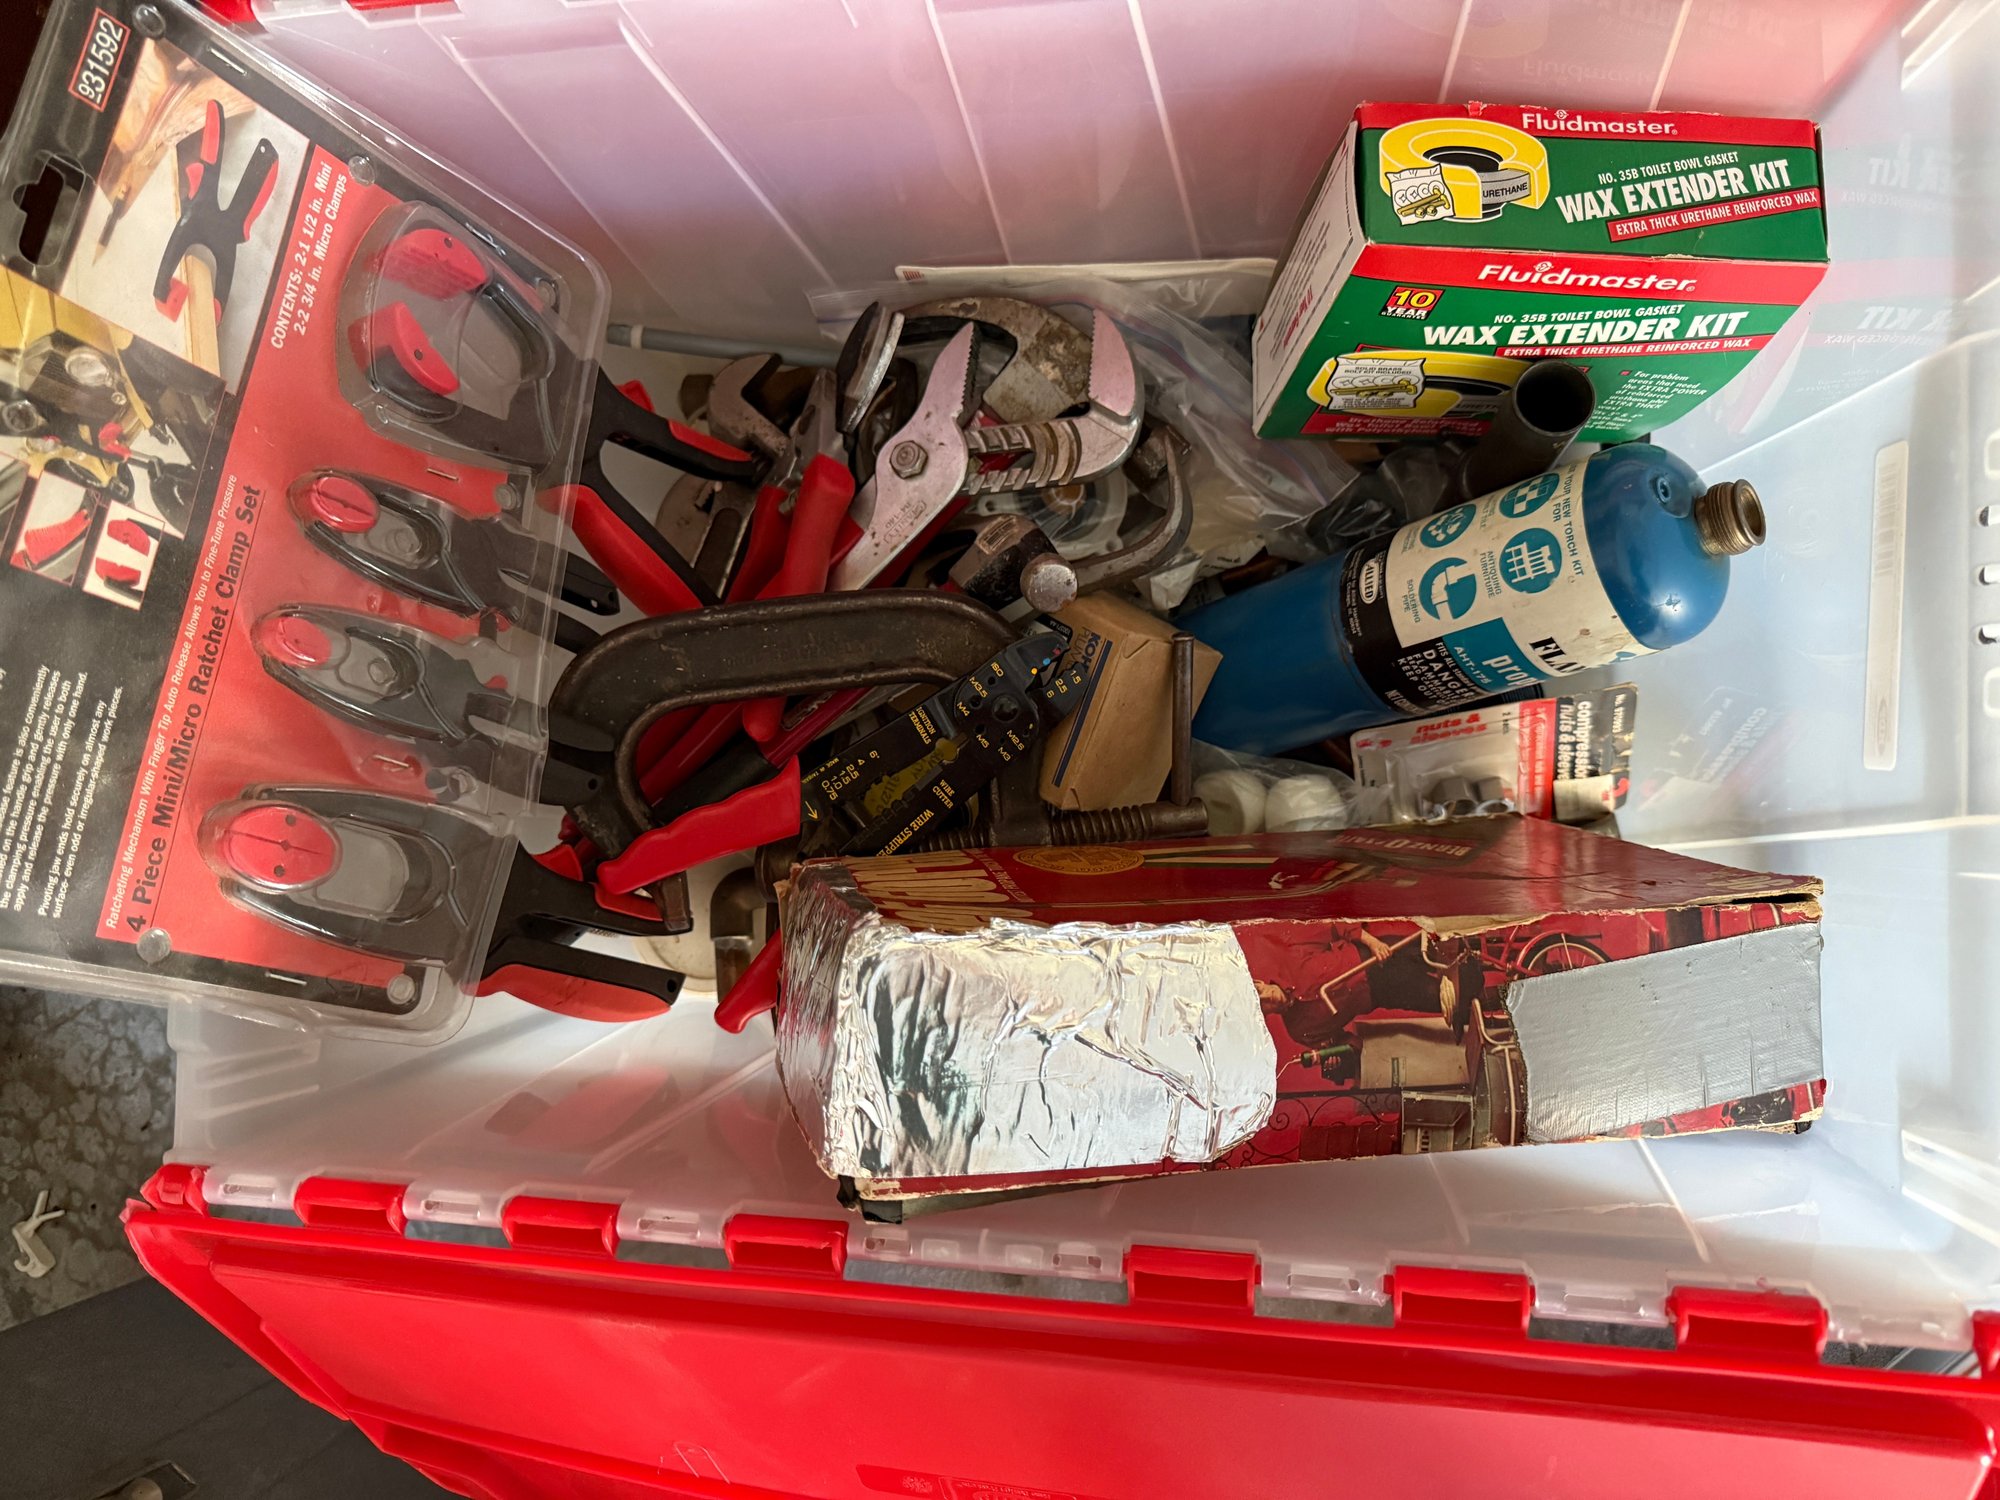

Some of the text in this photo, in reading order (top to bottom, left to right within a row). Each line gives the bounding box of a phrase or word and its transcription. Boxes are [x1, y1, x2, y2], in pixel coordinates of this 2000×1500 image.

[73, 17, 127, 103] 931592
[1521, 109, 1677, 135] Fluidmaster
[1598, 151, 1738, 184] NO. 35B TOILET BOWL GASKET
[1483, 182, 1528, 198] URETHANE
[1555, 159, 1792, 224] WAX EXTENDER KIT
[1616, 191, 1818, 237] EXTRA THICK URETHANE REINFORCED WAX
[269, 160, 334, 349] CONTENTS: 2-1 1/2 in. Mini
[292, 172, 350, 335] 2-2 3/4 in. Micro Clamps
[1477, 261, 1697, 292] Fluidmaster
[1387, 306, 1428, 316] YEAR
[1396, 290, 1436, 308] 10
[1494, 304, 1685, 324] NO. 35B TOILET BOWL GASKET
[1423, 311, 1750, 346] WAX EXTENDER KIT
[1503, 338, 1752, 357] EXTRA THICK URETHANE REINFORCED WAX
[1650, 373, 1689, 381] problem
[1610, 395, 1649, 403] urethane
[1626, 391, 1675, 399] reinforced
[1559, 475, 1575, 495] YOUR
[1550, 503, 1563, 521] FOR
[1558, 497, 1574, 519] NEW
[1560, 521, 1581, 556] TORCH
[1476, 552, 1496, 598] FURNITURE
[1484, 550, 1503, 595] ANTIQUING
[1571, 559, 1584, 576] KIT
[1360, 563, 1377, 599] ALLIED
[1401, 594, 1412, 612] PIPE
[1405, 579, 1422, 623] SOLDERING
[1434, 641, 1457, 673] FITS ALL
[1453, 647, 1489, 685] AHT-175
[1054, 677, 1068, 693] 2.5
[1068, 669, 1081, 684] 1.5
[1397, 656, 1435, 703] KEEP OUT
[1422, 649, 1473, 700] DANGER
[40, 668, 62, 711] releases
[56, 679, 72, 703] both
[968, 675, 988, 699] M3.5
[1045, 689, 1055, 698] 6
[16, 663, 52, 747] also conveniently
[53, 702, 65, 714] to
[104, 473, 238, 929] Ratcheting Mechanism With Finger Tip Auto Release Allows You to Fine-Tune Pressure
[125, 485, 260, 933] 4 Piece Mini/Micro Ratchet Clamp Set
[955, 700, 970, 718] M4
[31, 710, 51, 742] gently
[47, 714, 62, 737] user
[907, 711, 932, 745] TERMINALS
[914, 706, 937, 735] IGNITION
[1415, 718, 1462, 733] nuts
[1558, 704, 1575, 743] nuts &
[25, 741, 40, 762] and
[42, 736, 55, 755] the
[975, 732, 990, 749] M5
[1005, 728, 1025, 752] M2.6
[1572, 701, 1593, 779] compression
[856, 756, 865, 766] 4
[868, 749, 878, 759] 6
[997, 746, 1011, 762] M3
[19, 762, 36, 783] grip
[29, 754, 52, 799] enabling
[60, 684, 125, 877] even odd or irregular-shaped work pieces.
[829, 774, 843, 790] 1.0
[837, 769, 851, 785] 1.5
[845, 762, 860, 780] 2.5
[14, 669, 89, 913] apply and release the pressure with only one hand.
[820, 778, 838, 801] 0.75
[931, 782, 954, 810] CUTTER
[938, 777, 955, 798] WIRE
[8, 782, 28, 818] handle
[37, 698, 108, 917] Pivoting jaw ends hold securely on almost any
[4, 818, 18, 837] the
[17, 798, 40, 842] pressure
[908, 807, 934, 831] WIRE
[2, 841, 27, 890] clamping
